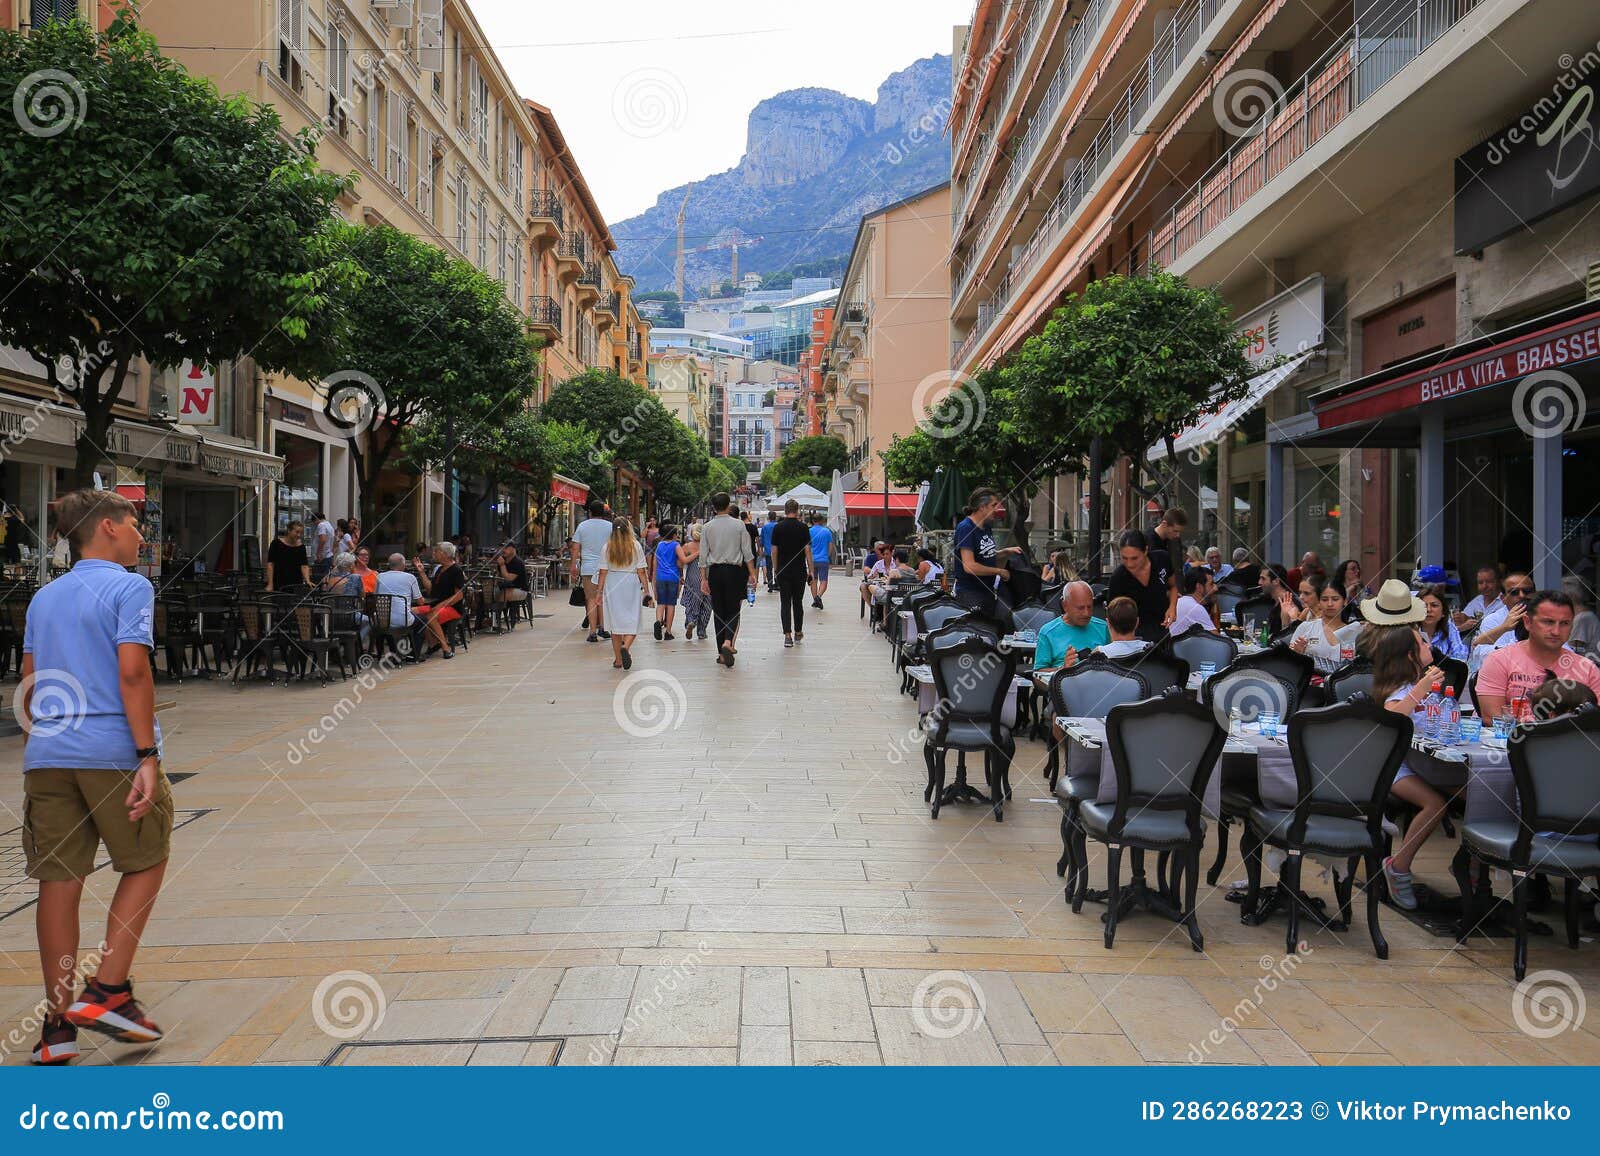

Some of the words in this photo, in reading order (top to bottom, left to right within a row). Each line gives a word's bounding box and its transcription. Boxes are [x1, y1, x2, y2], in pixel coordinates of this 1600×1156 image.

[1421, 370, 1466, 402] BELLA
[1471, 357, 1507, 386] VITA
[1517, 323, 1600, 376] BRASSE
[166, 441, 192, 461] SALADES
